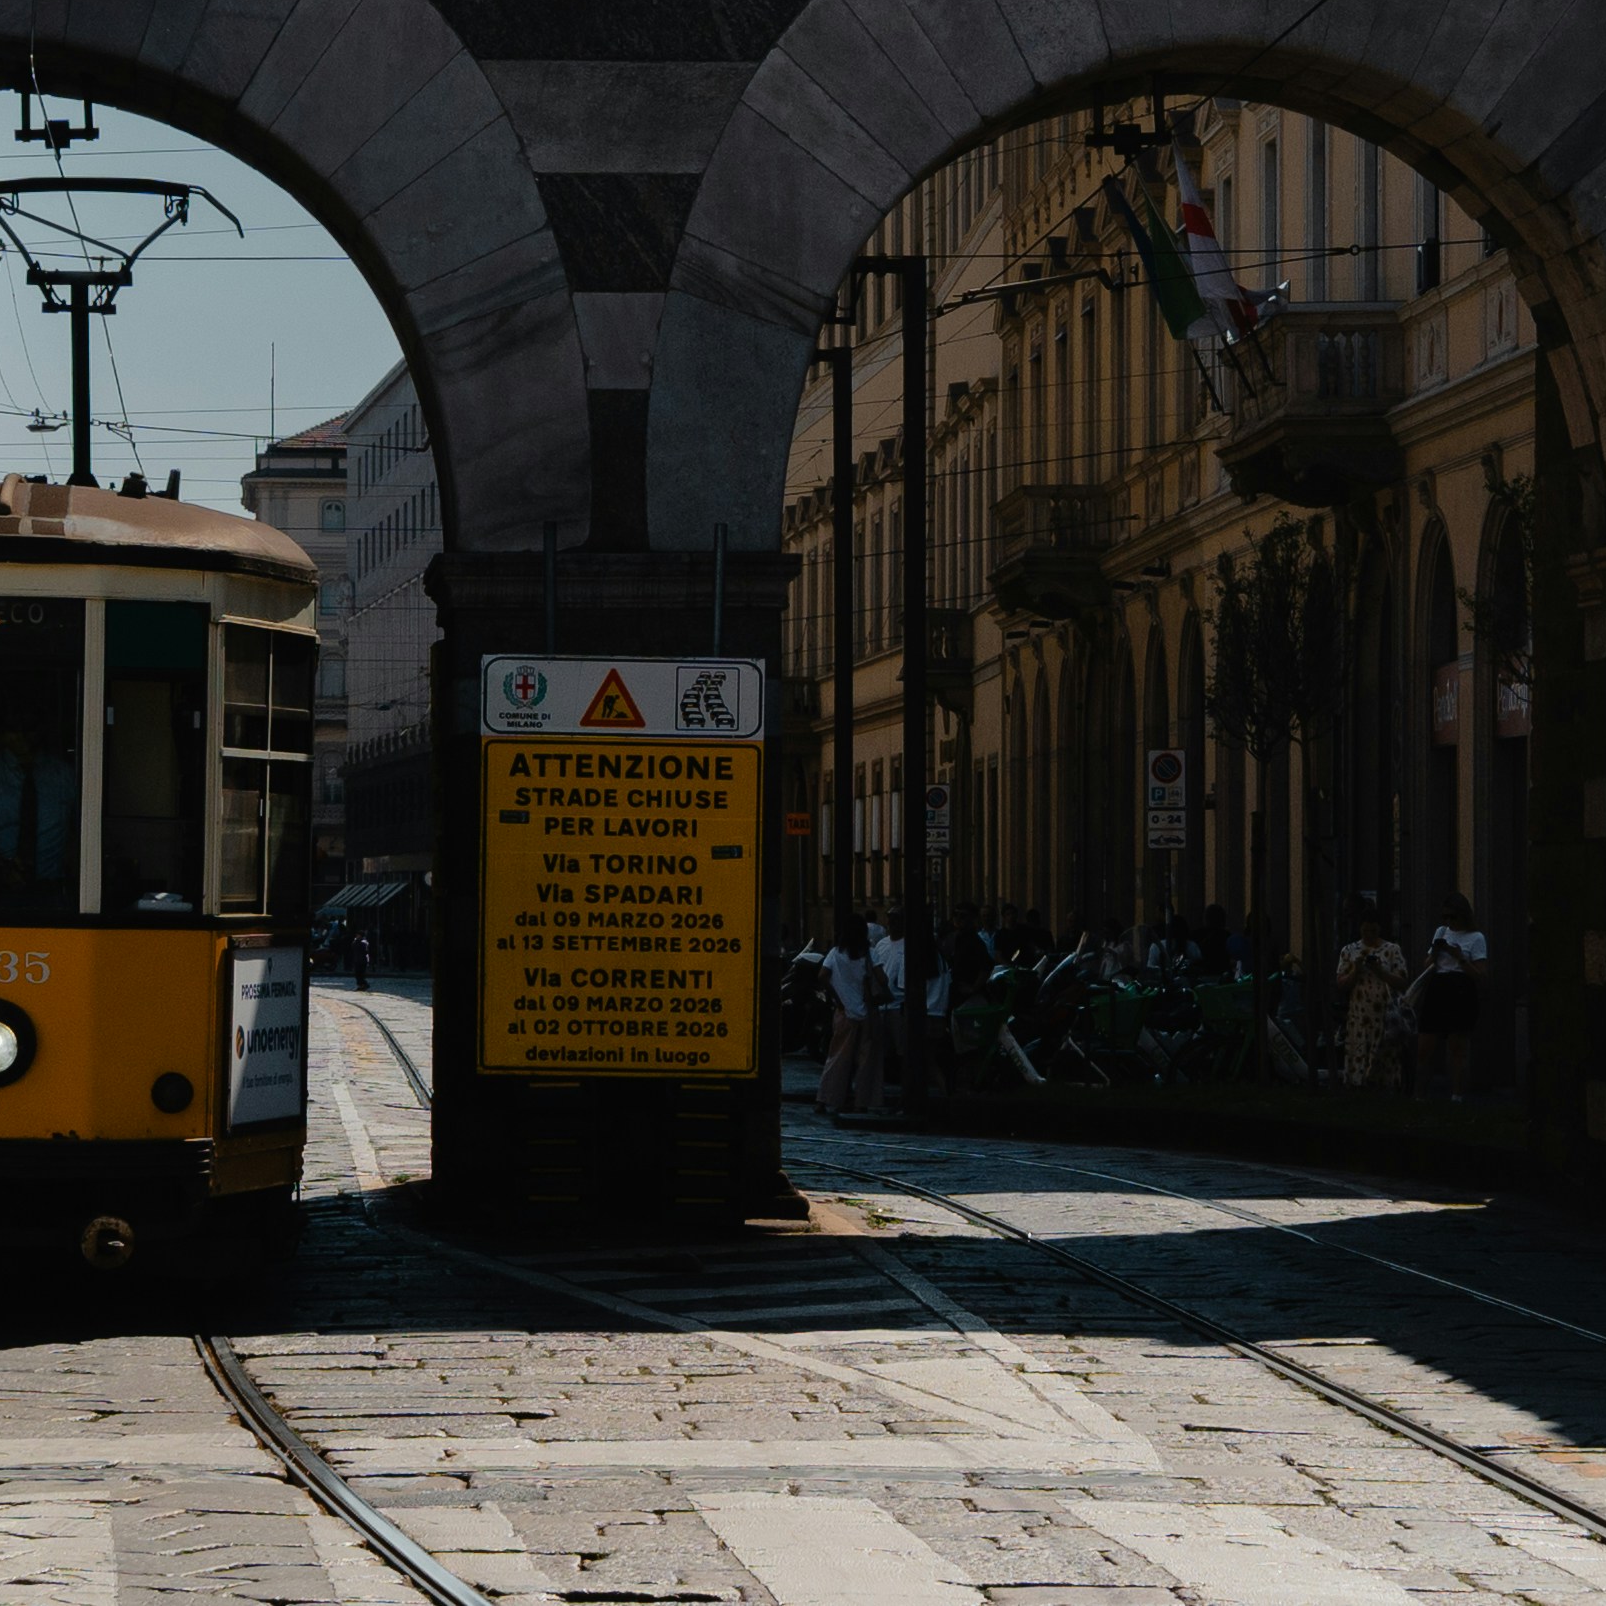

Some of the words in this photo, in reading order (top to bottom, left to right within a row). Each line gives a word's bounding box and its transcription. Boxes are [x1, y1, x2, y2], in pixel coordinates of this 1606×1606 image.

[510, 753, 733, 780] ATTENZIONE
[515, 787, 618, 807] STRADE
[628, 790, 727, 809] CHIUSE
[545, 817, 593, 835] PER
[604, 818, 697, 837] LAVORI
[1168, 815, 1181, 823] 24
[543, 854, 580, 873] Via
[590, 854, 697, 875] TORINO
[537, 883, 573, 903] Via
[585, 884, 702, 905] SPADARI
[515, 912, 546, 926] dal
[554, 911, 580, 927] 09
[588, 912, 664, 928] MARZO
[672, 913, 723, 929] 2026
[497, 935, 515, 950] al
[523, 935, 543, 950] 13
[553, 935, 681, 952] SETTEMBRE
[689, 938, 741, 953] 2026
[524, 968, 561, 987] Via
[571, 968, 712, 989] CORRENTI
[242, 982, 270, 999] PROSSIMA
[514, 996, 546, 1011] dal
[553, 996, 579, 1011] 09
[587, 996, 663, 1012] MARZO
[670, 998, 722, 1013] 2026
[508, 1019, 526, 1034] al
[534, 1019, 559, 1034] 02
[567, 1020, 668, 1036] OTTOBRE
[676, 1021, 728, 1037] 2026
[247, 1025, 300, 1059] unoenergy
[526, 1046, 623, 1062] deviazioni
[631, 1047, 648, 1062] in
[655, 1048, 710, 1066] luogo
